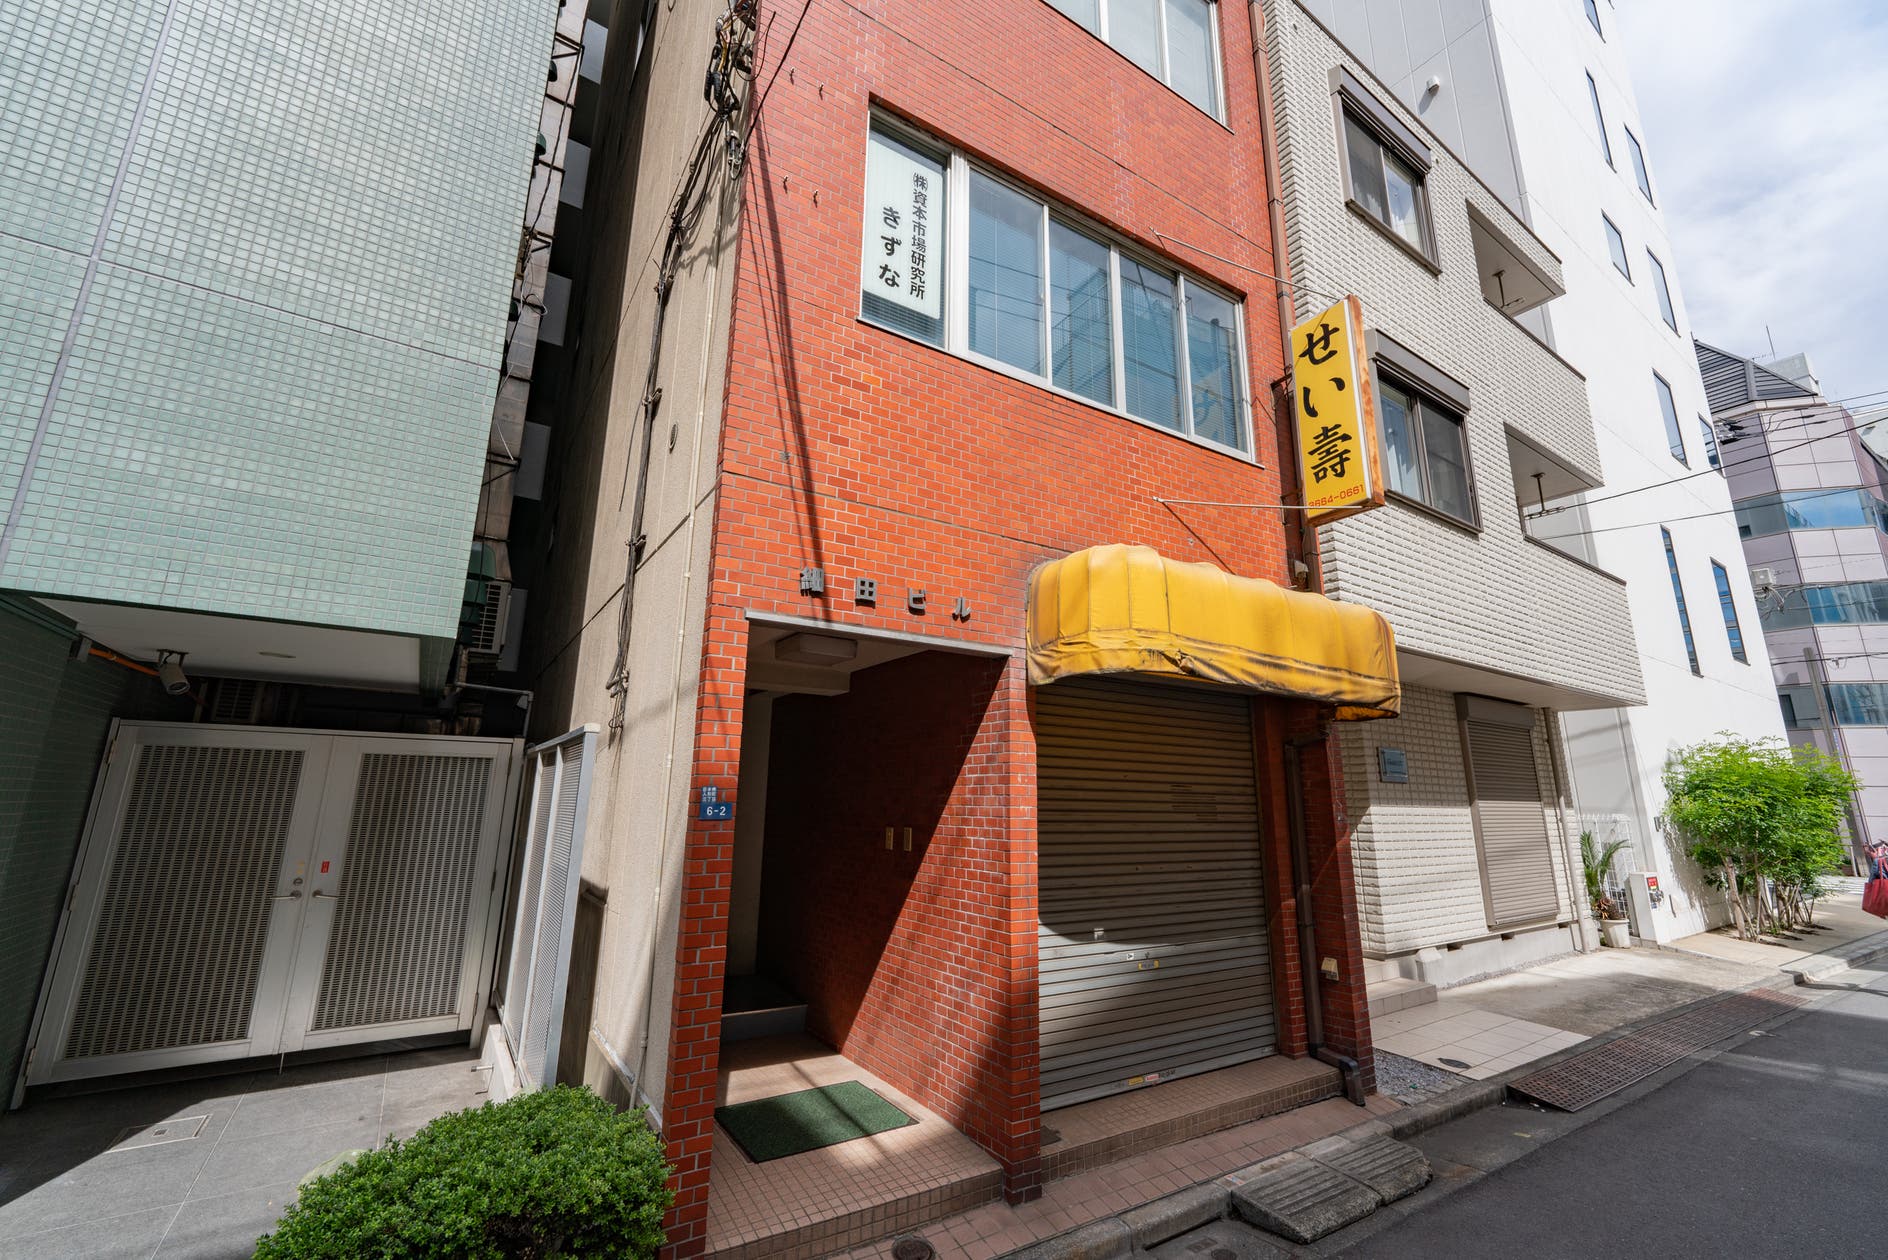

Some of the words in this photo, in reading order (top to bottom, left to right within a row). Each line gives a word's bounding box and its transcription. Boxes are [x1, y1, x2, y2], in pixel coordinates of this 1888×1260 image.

[879, 206, 902, 288] きずな
[706, 806, 726, 816] 6-2
